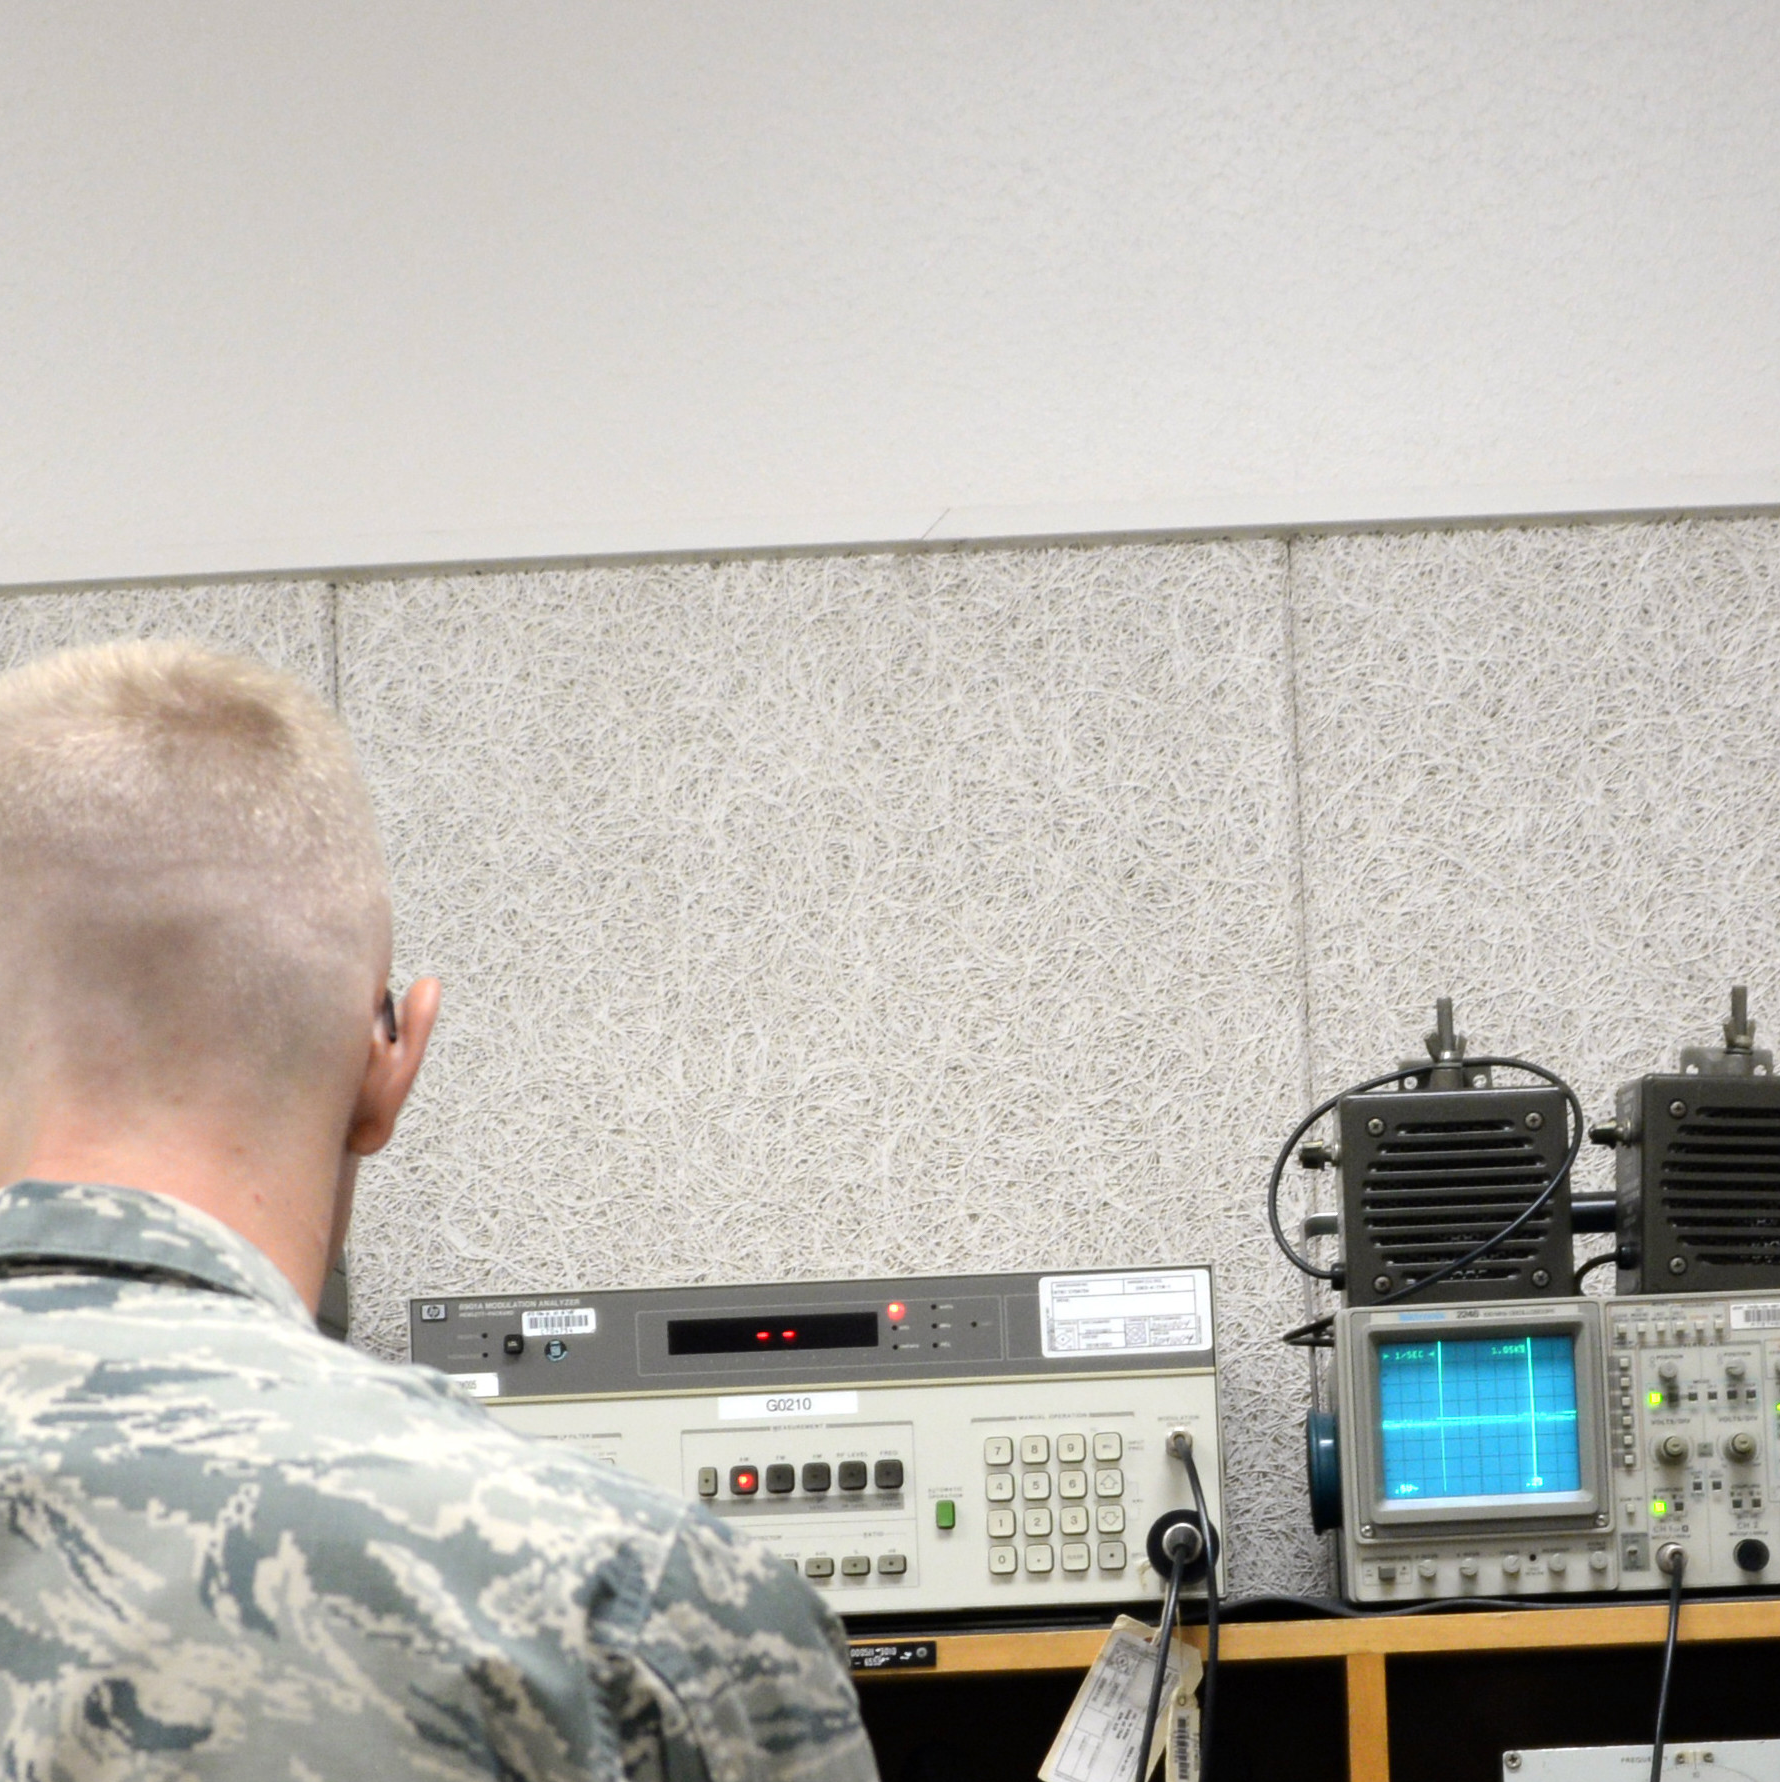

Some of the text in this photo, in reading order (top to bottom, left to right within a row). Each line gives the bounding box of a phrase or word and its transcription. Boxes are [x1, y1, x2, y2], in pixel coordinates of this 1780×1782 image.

[485, 1300, 537, 1310] MODULATION
[538, 1299, 581, 1308] ANALYZER
[994, 1446, 1002, 1456] 7
[1031, 1444, 1039, 1455] 8
[1066, 1443, 1074, 1453] 9
[995, 1482, 1004, 1492] 4
[1032, 1480, 1040, 1490] 5
[1068, 1479, 1077, 1489] 6
[998, 1518, 1004, 1528] 1
[1033, 1517, 1042, 1527] 2
[1070, 1516, 1078, 1526] 3
[1736, 1522, 1750, 1530] CH
[1653, 1525, 1667, 1533] CH
[998, 1555, 1006, 1565] 0
